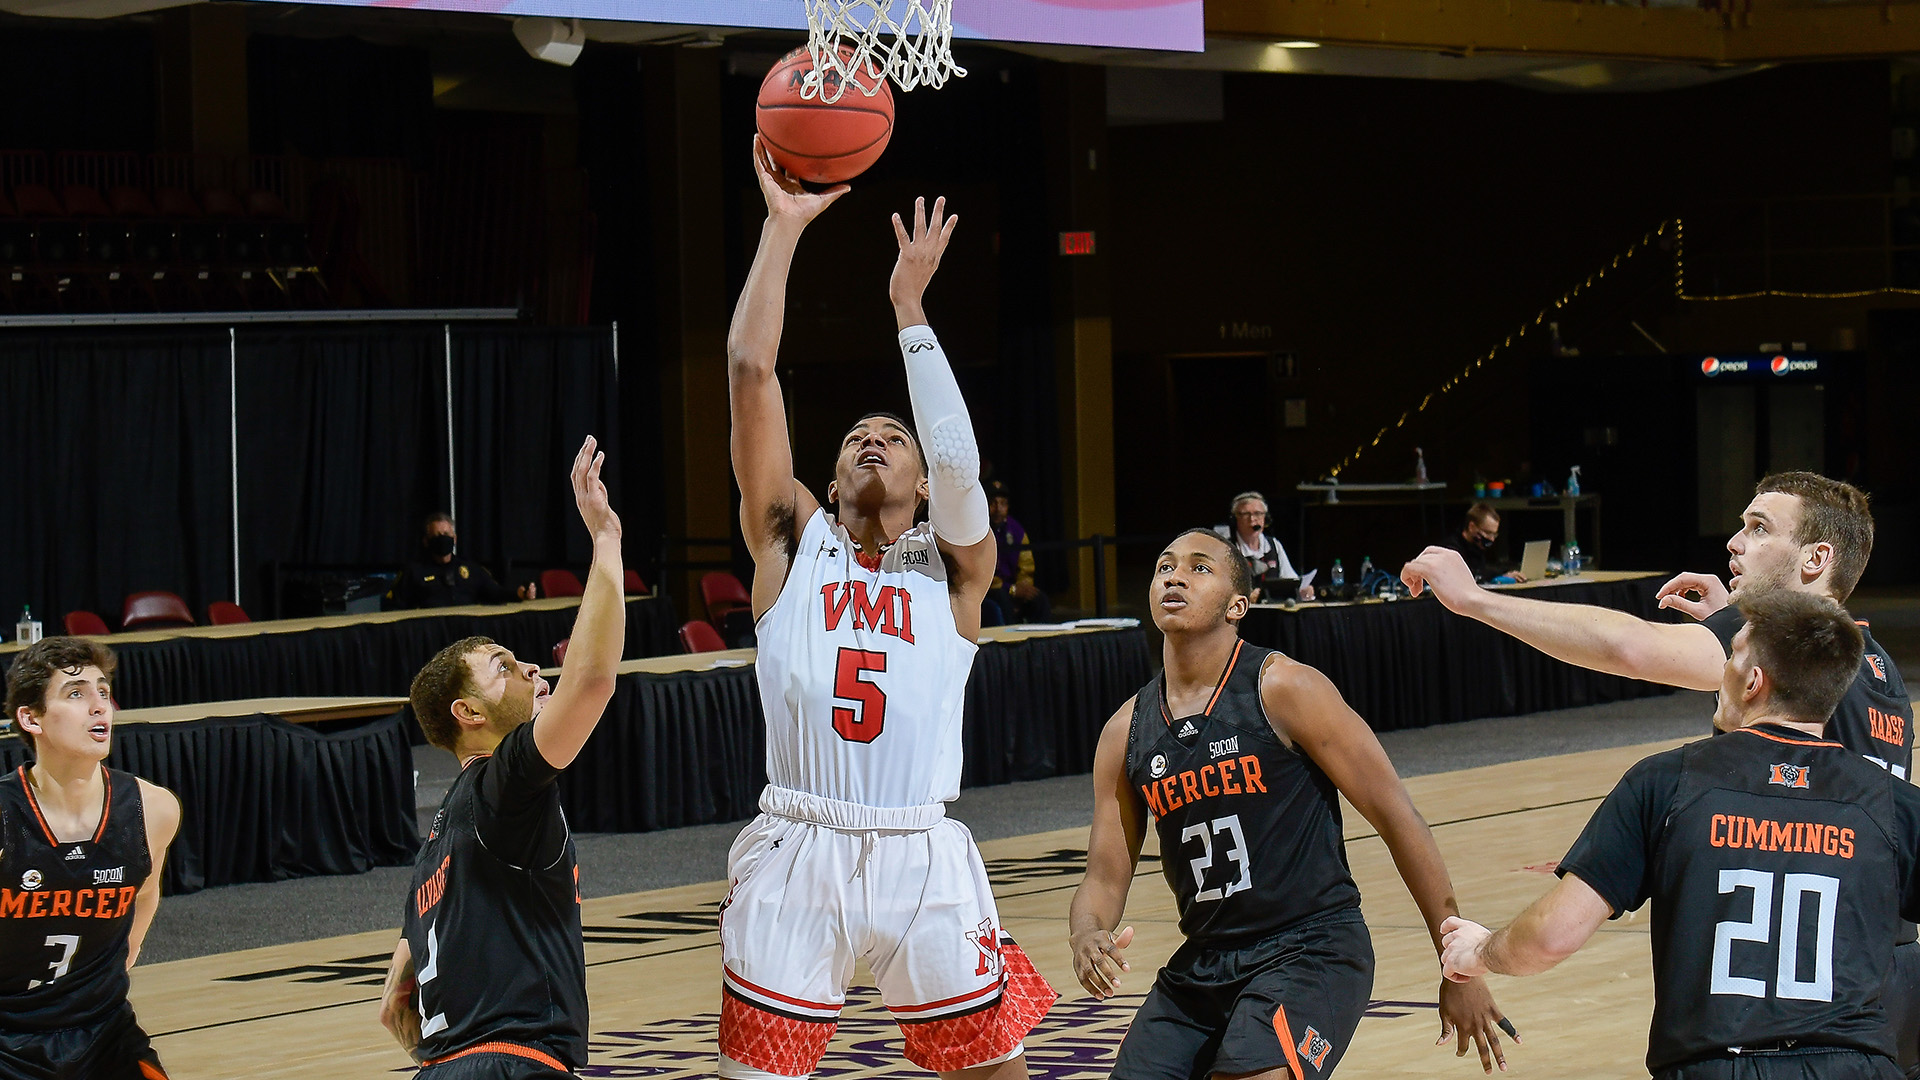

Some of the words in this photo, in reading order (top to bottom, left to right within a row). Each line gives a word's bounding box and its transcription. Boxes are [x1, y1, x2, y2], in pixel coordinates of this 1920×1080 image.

[1066, 232, 1091, 254] EXIT
[1232, 321, 1272, 339] Men
[1720, 361, 1748, 372] pepsi
[1790, 360, 1818, 371] pepsi
[820, 580, 915, 645] VMI
[832, 646, 887, 744] 5
[1177, 728, 1199, 739] adidas
[1867, 707, 1905, 747] HAASE
[1209, 735, 1239, 760] SOCON
[1142, 755, 1267, 823] MERCER
[1710, 813, 1855, 859] CUMMINGS
[92, 866, 124, 885] SOCON
[1182, 814, 1252, 902] 23
[0, 886, 136, 919] MERCER
[1710, 868, 1840, 1003] 20
[28, 935, 80, 990] 3
